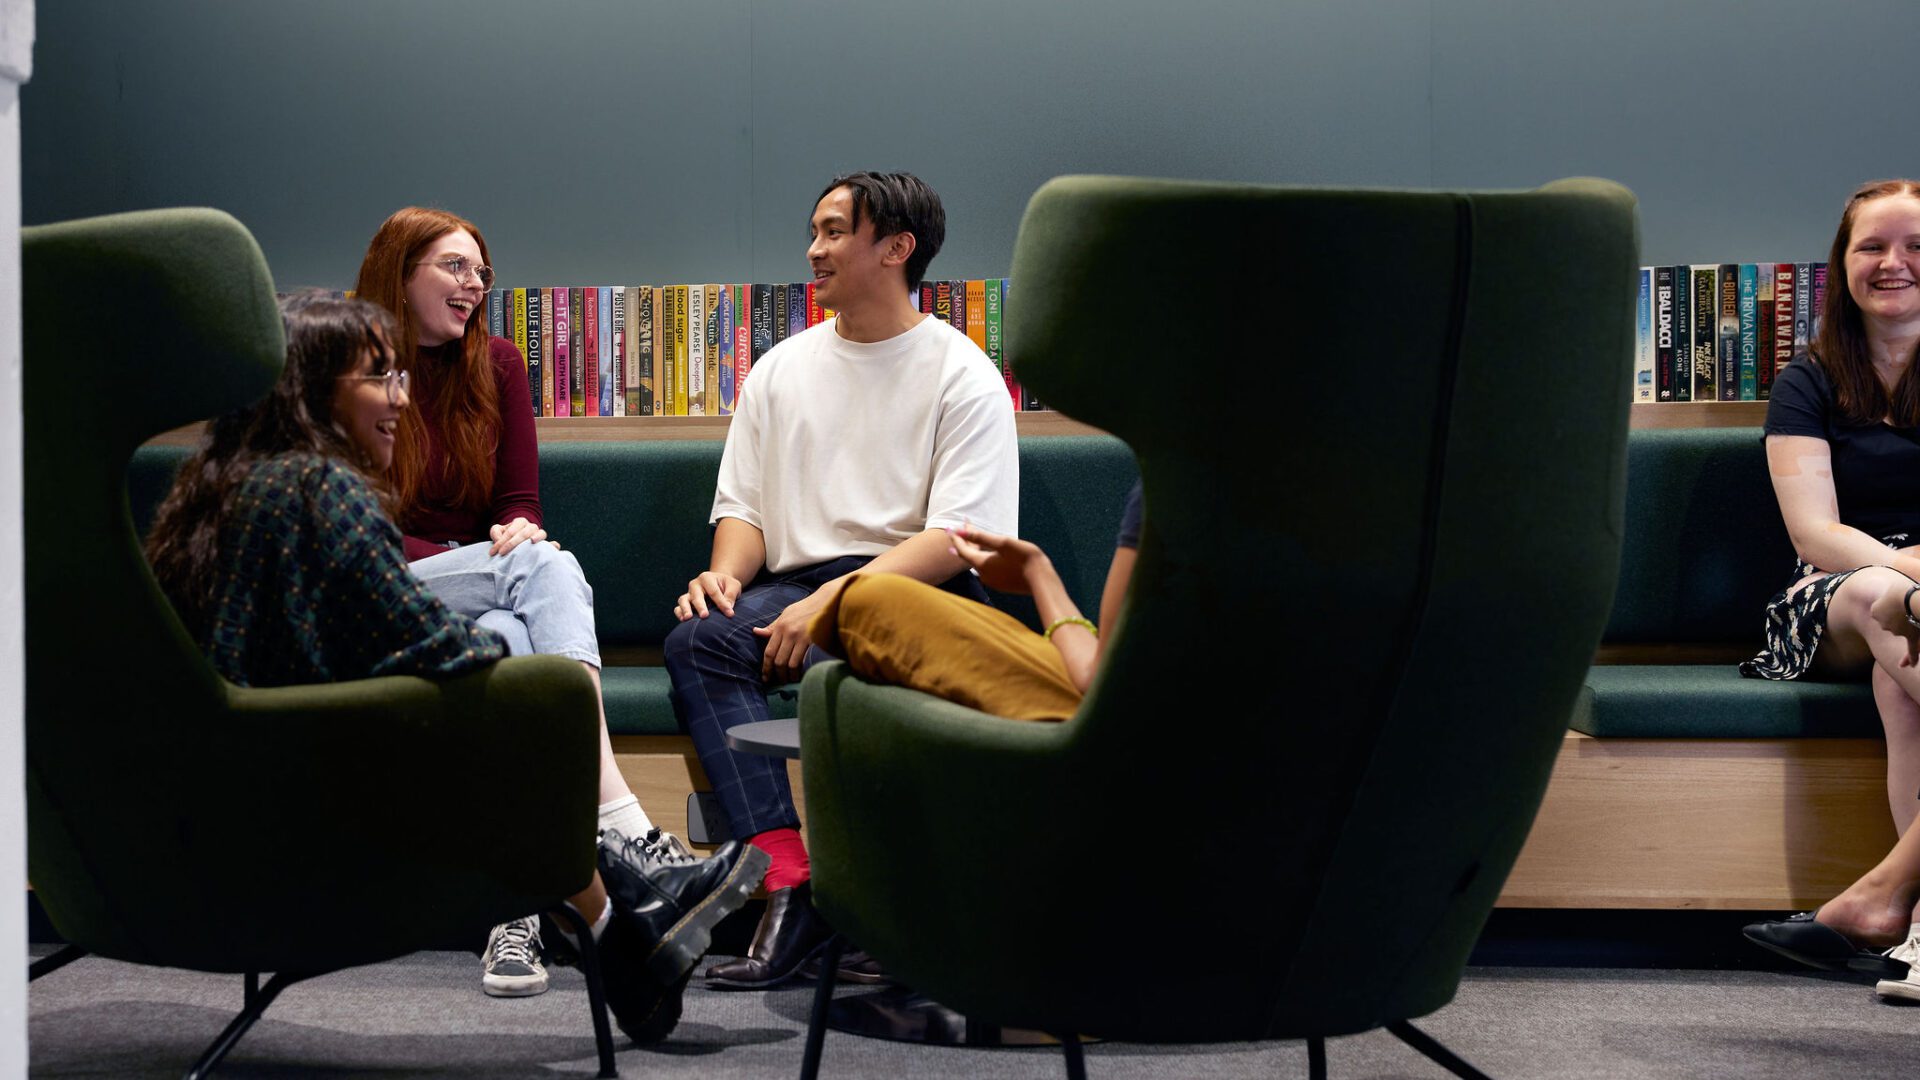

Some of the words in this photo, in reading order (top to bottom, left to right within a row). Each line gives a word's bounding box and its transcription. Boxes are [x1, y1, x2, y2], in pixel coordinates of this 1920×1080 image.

[1744, 278, 1752, 294] THE
[1798, 268, 1809, 286] SAM
[1814, 267, 1827, 286] THE
[529, 296, 539, 326] BLUE
[614, 292, 624, 318] POSTER
[665, 294, 674, 330] DANGEROUS
[678, 288, 686, 315] blood
[692, 290, 700, 319] LESLEY
[708, 290, 717, 308] The
[762, 290, 771, 328] Australia
[790, 288, 798, 327] FELLOWES
[922, 288, 932, 314] ADRIA
[936, 284, 951, 314] DAISY
[954, 294, 962, 332] MADUKK
[988, 286, 998, 314] TONI
[1698, 276, 1707, 327] GALBRAITH
[1723, 282, 1736, 316] BURIED
[1742, 296, 1754, 330] TRIVIA
[1798, 290, 1808, 316] FROST
[492, 296, 503, 337] funkytow
[542, 294, 552, 335] GUDYARRA
[614, 320, 624, 336] GIRL
[708, 310, 717, 344] Picture
[1658, 290, 1672, 348] BALDACCI
[1776, 272, 1792, 370] BANJAWARN
[517, 320, 525, 344] FLYNN
[557, 321, 567, 350] GIRL
[676, 318, 684, 344] sugar
[693, 321, 701, 353] PEARSE
[754, 322, 762, 350] Pacific
[760, 328, 772, 340] &
[989, 320, 998, 366] JORDAN
[529, 330, 540, 366] HOUR
[665, 332, 674, 360] BUSINESS
[708, 346, 717, 371] Bride
[1704, 342, 1712, 354] INK
[1742, 332, 1754, 368] NIGHT
[692, 356, 702, 392] Deception
[1696, 346, 1704, 376] HEART
[1704, 354, 1712, 380] BLACK
